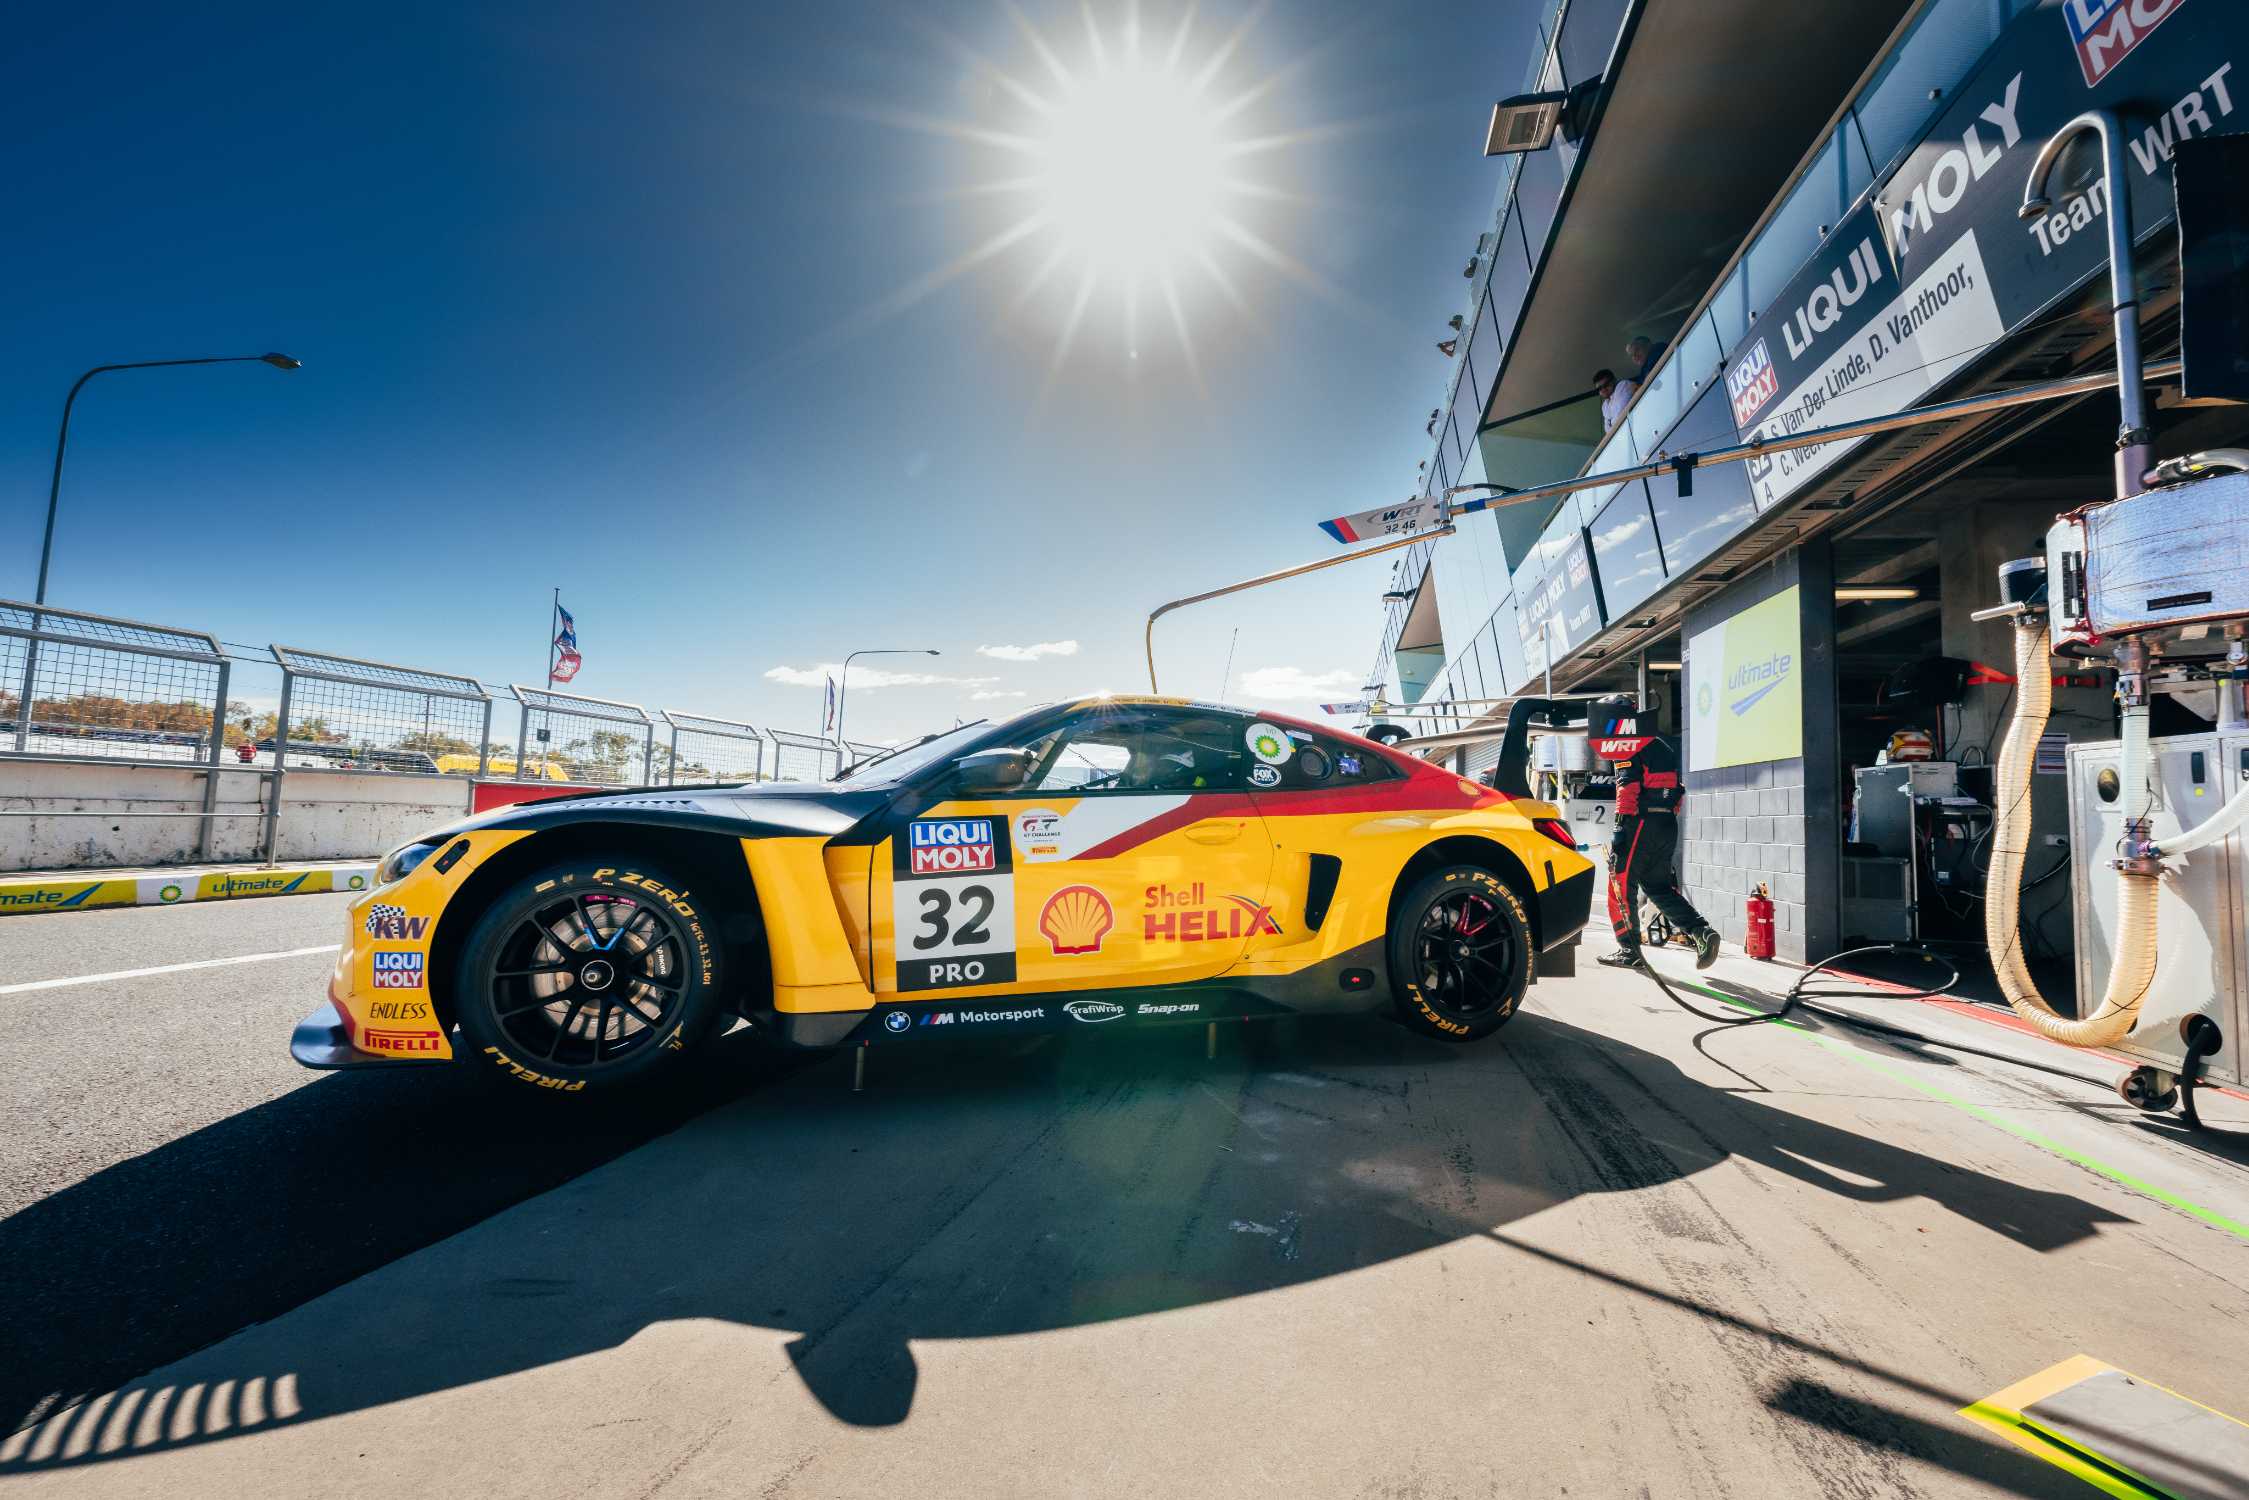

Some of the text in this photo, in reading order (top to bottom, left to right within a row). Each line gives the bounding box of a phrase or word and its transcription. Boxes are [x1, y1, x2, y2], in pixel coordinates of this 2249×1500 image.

[2129, 62, 2233, 176] WRT
[1782, 71, 2022, 361] LIQUI MOLY
[1781, 409, 1805, 434] Van
[1803, 387, 1826, 417] Der
[1825, 354, 1872, 398] Linde,
[1869, 333, 1889, 362] D.
[1887, 263, 1974, 345] Vanthoor,
[1730, 343, 1768, 396] LIQUI
[1736, 366, 1774, 422] MOLY
[1780, 454, 1793, 476] C.
[1764, 482, 1774, 503] A
[1728, 652, 1792, 690] ultimate
[1601, 740, 1641, 752] WRT
[1252, 768, 1274, 779] FOX
[1591, 775, 1617, 784] WR
[1594, 805, 1606, 825] 2
[915, 822, 988, 846] LIQUI
[916, 846, 991, 871] MOLY
[213, 877, 284, 893] ultimate
[1144, 882, 1204, 908] Shell
[0, 890, 64, 905] mate
[372, 915, 430, 940] KW
[913, 885, 995, 951] 32
[1144, 899, 1280, 942] HELIX
[375, 953, 422, 970] LIQUI
[929, 960, 985, 984] PRO
[375, 971, 422, 988] MOLY
[370, 1002, 428, 1020] ENDLESS
[960, 1007, 1045, 1023] Motorsport
[1070, 1003, 1124, 1015] GrafiWrap
[1137, 1003, 1200, 1014] Snap-on
[1407, 983, 1471, 1036] PIRELLI
[364, 1028, 440, 1051] PIRELLI
[484, 1046, 587, 1091] PIRELLI
